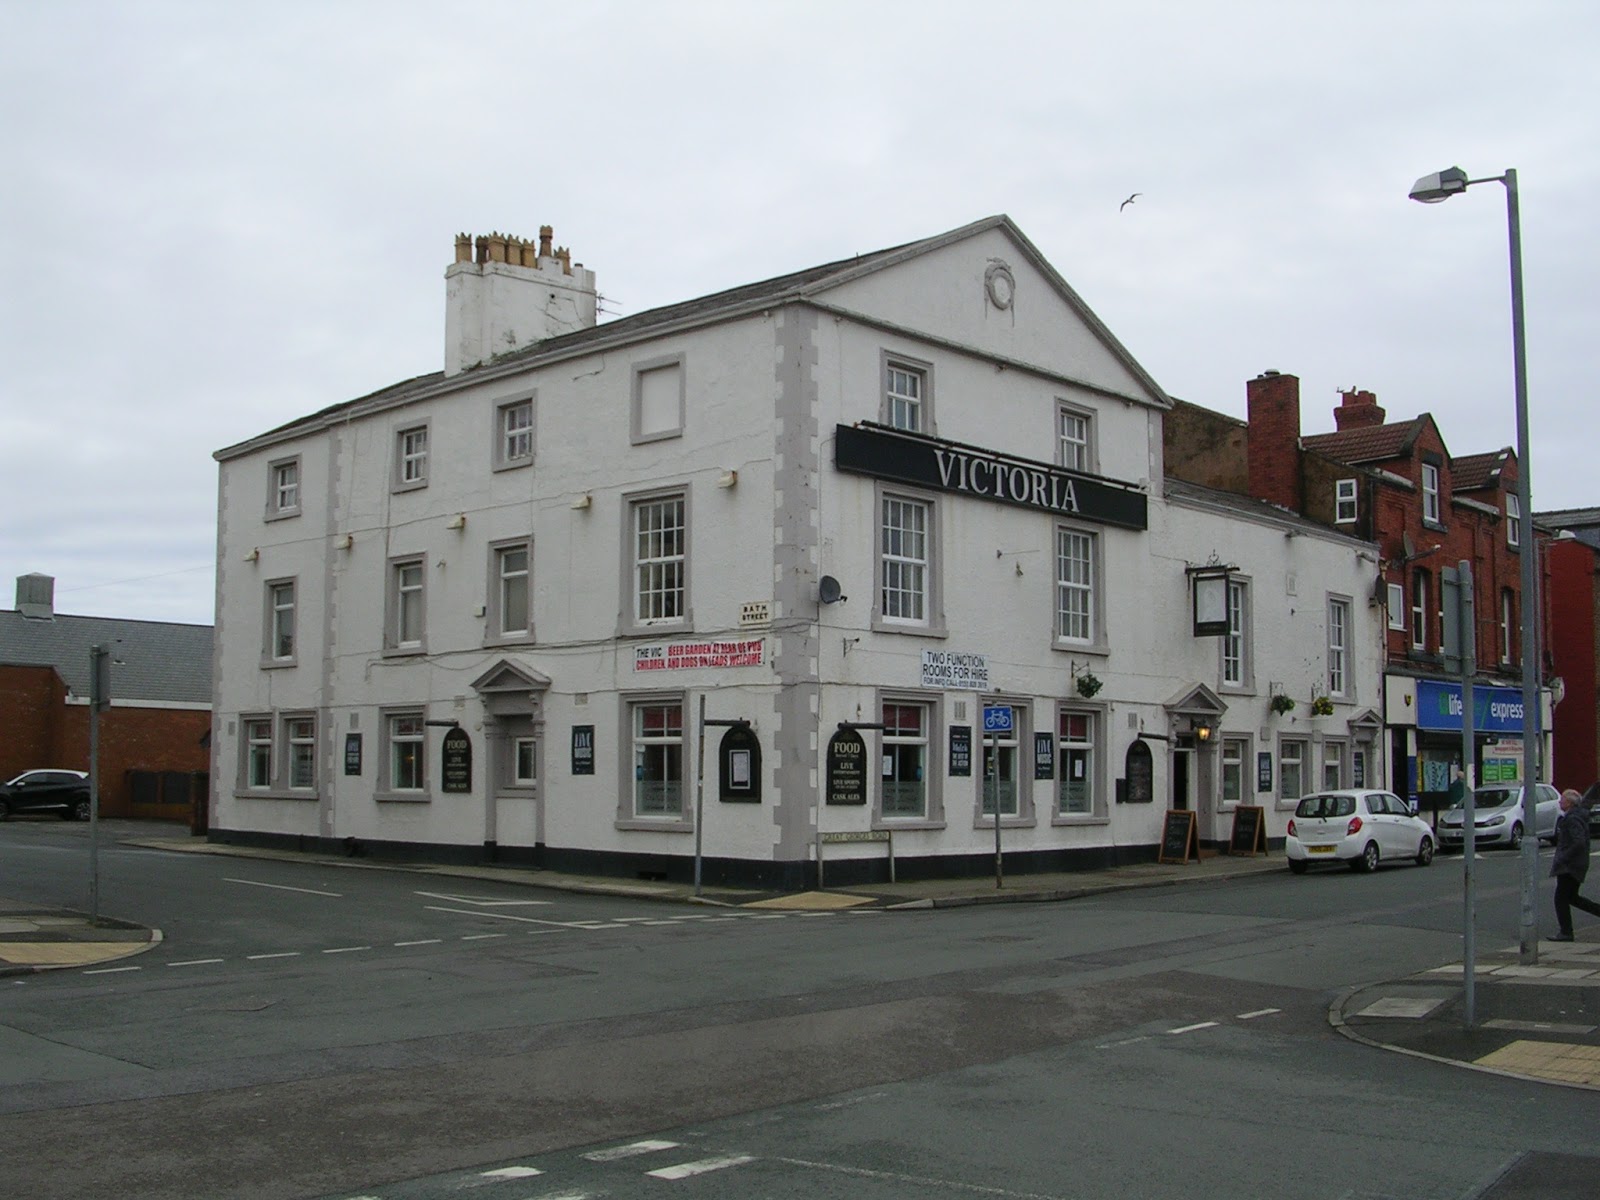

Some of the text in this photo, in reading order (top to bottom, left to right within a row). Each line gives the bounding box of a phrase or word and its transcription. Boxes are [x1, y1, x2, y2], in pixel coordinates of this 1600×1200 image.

[934, 450, 1080, 513] VICTORIA
[742, 613, 768, 621] STREET
[743, 605, 767, 613] BATH
[636, 648, 649, 658] THE
[651, 647, 662, 657] VIC
[668, 644, 684, 656] BEER
[685, 643, 711, 655] GARDEN
[747, 640, 762, 652] PUB
[636, 653, 762, 671] CHILDREN AND DOGS ON LEADS WELCOME
[927, 651, 985, 667] TWO FUNCTION
[923, 664, 988, 681] ROOMS FOR HIRE
[924, 677, 934, 685] FOR
[935, 678, 945, 686] INFO
[946, 679, 958, 687] CALL
[1491, 702, 1524, 723] express
[447, 740, 467, 749] FOOD
[834, 742, 860, 754] FOOD
